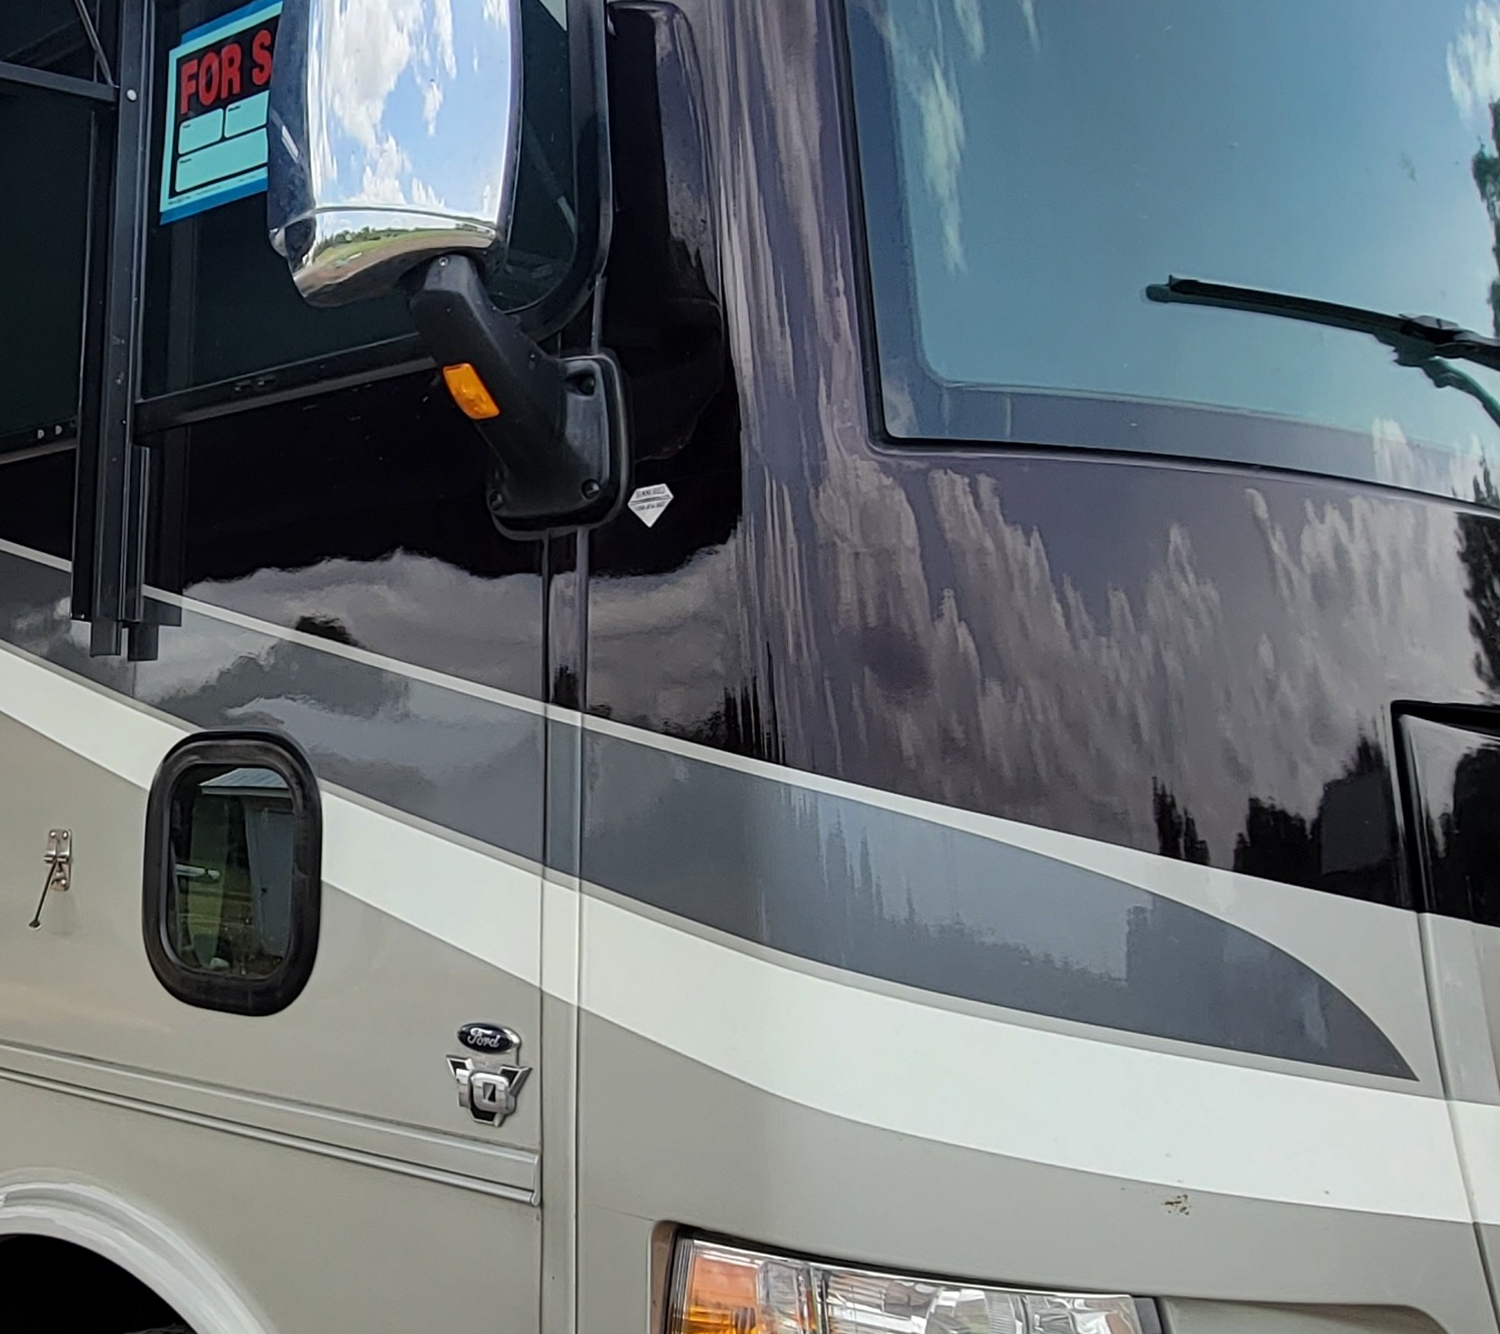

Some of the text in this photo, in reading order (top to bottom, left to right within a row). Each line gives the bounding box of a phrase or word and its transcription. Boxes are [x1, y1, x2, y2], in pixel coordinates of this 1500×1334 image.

[179, 29, 273, 116] FOR S
[466, 1026, 501, 1049] Ford
